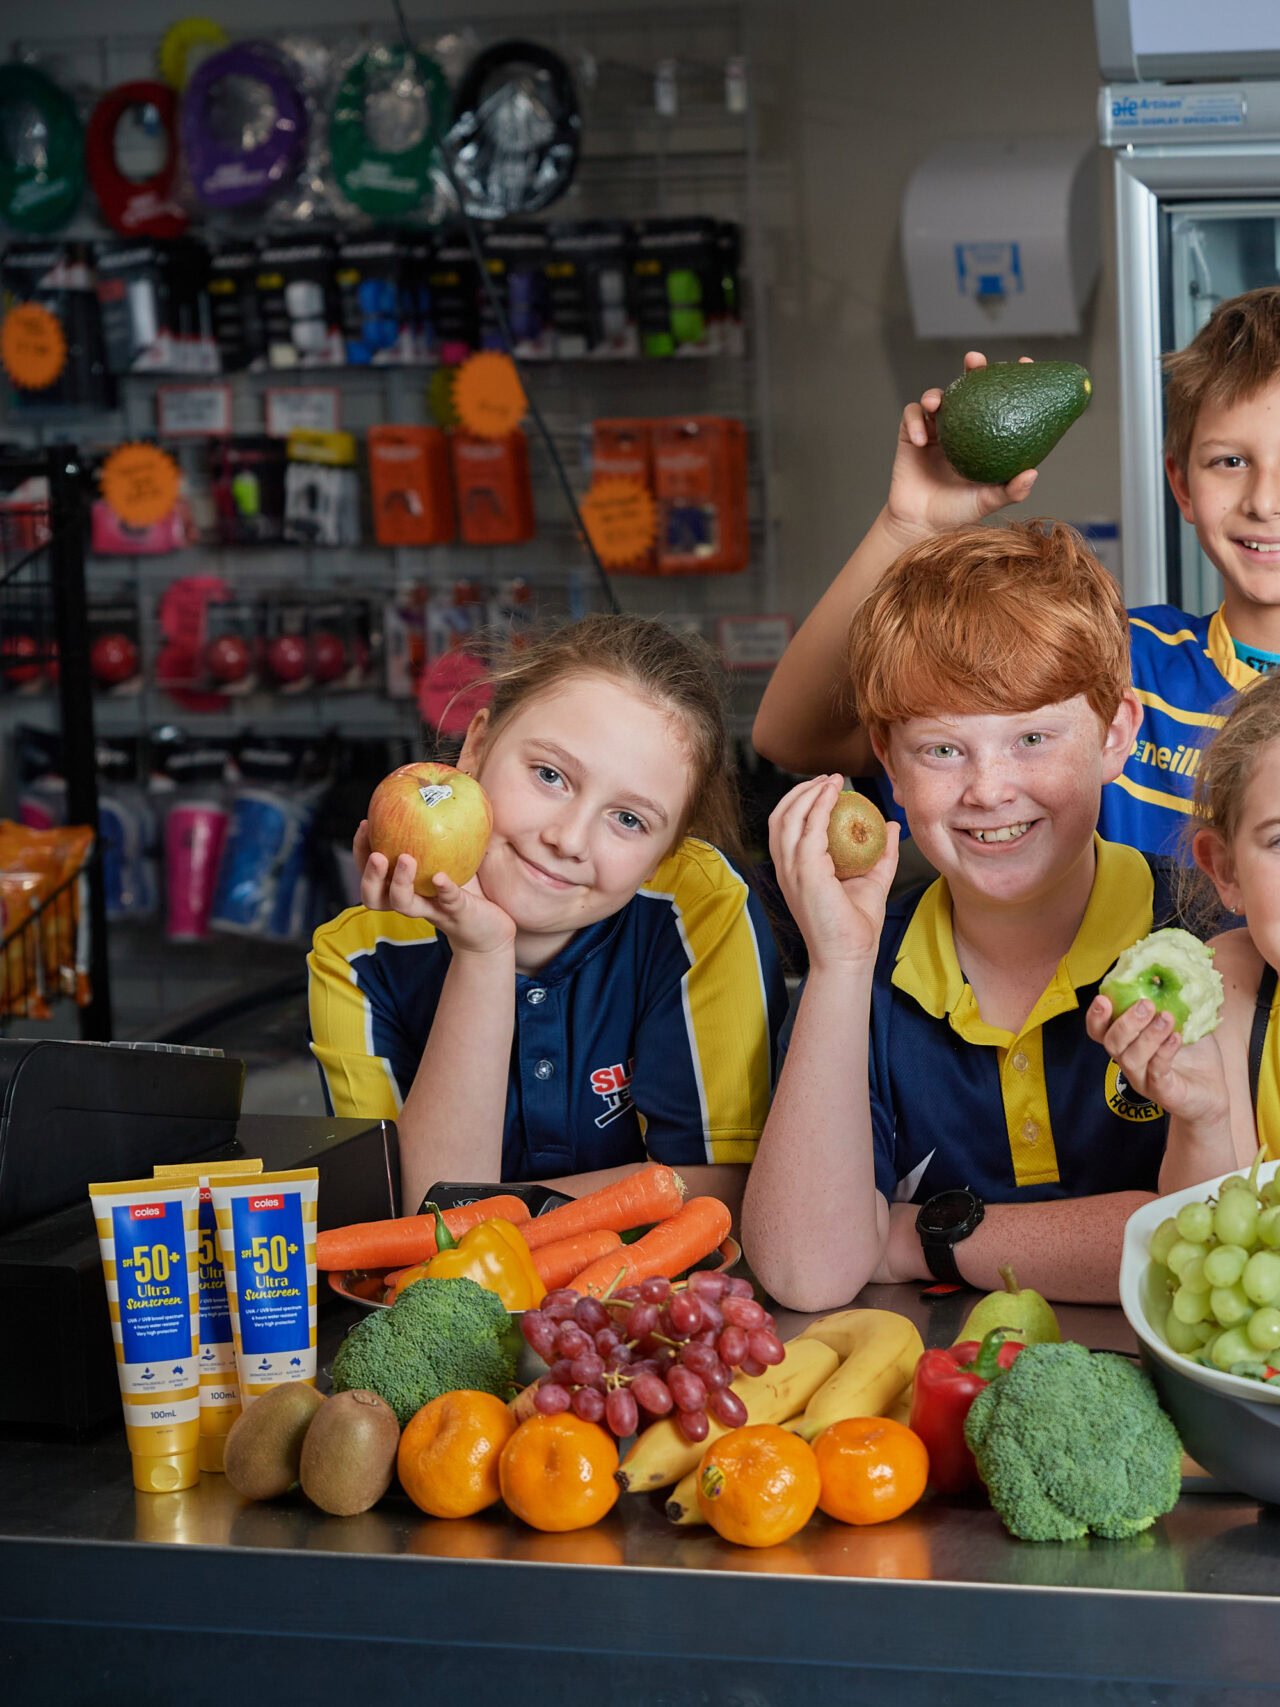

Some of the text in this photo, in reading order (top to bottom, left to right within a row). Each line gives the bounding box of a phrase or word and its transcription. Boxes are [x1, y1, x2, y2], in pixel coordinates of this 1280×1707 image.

[1109, 1094, 1160, 1119] HOCKEY
[254, 1199, 279, 1208] coles
[135, 1207, 160, 1217] coles
[241, 1235, 298, 1274] SPF 50+
[122, 1243, 180, 1283] SPF 50+
[200, 1267, 225, 1279] Ultr
[256, 1275, 288, 1288] Ultra
[137, 1284, 170, 1298] Ultra
[245, 1288, 301, 1301] Sunscreen
[126, 1297, 182, 1310] Sunscreen
[211, 1390, 236, 1400] 100mL
[150, 1409, 177, 1420] 100mL
